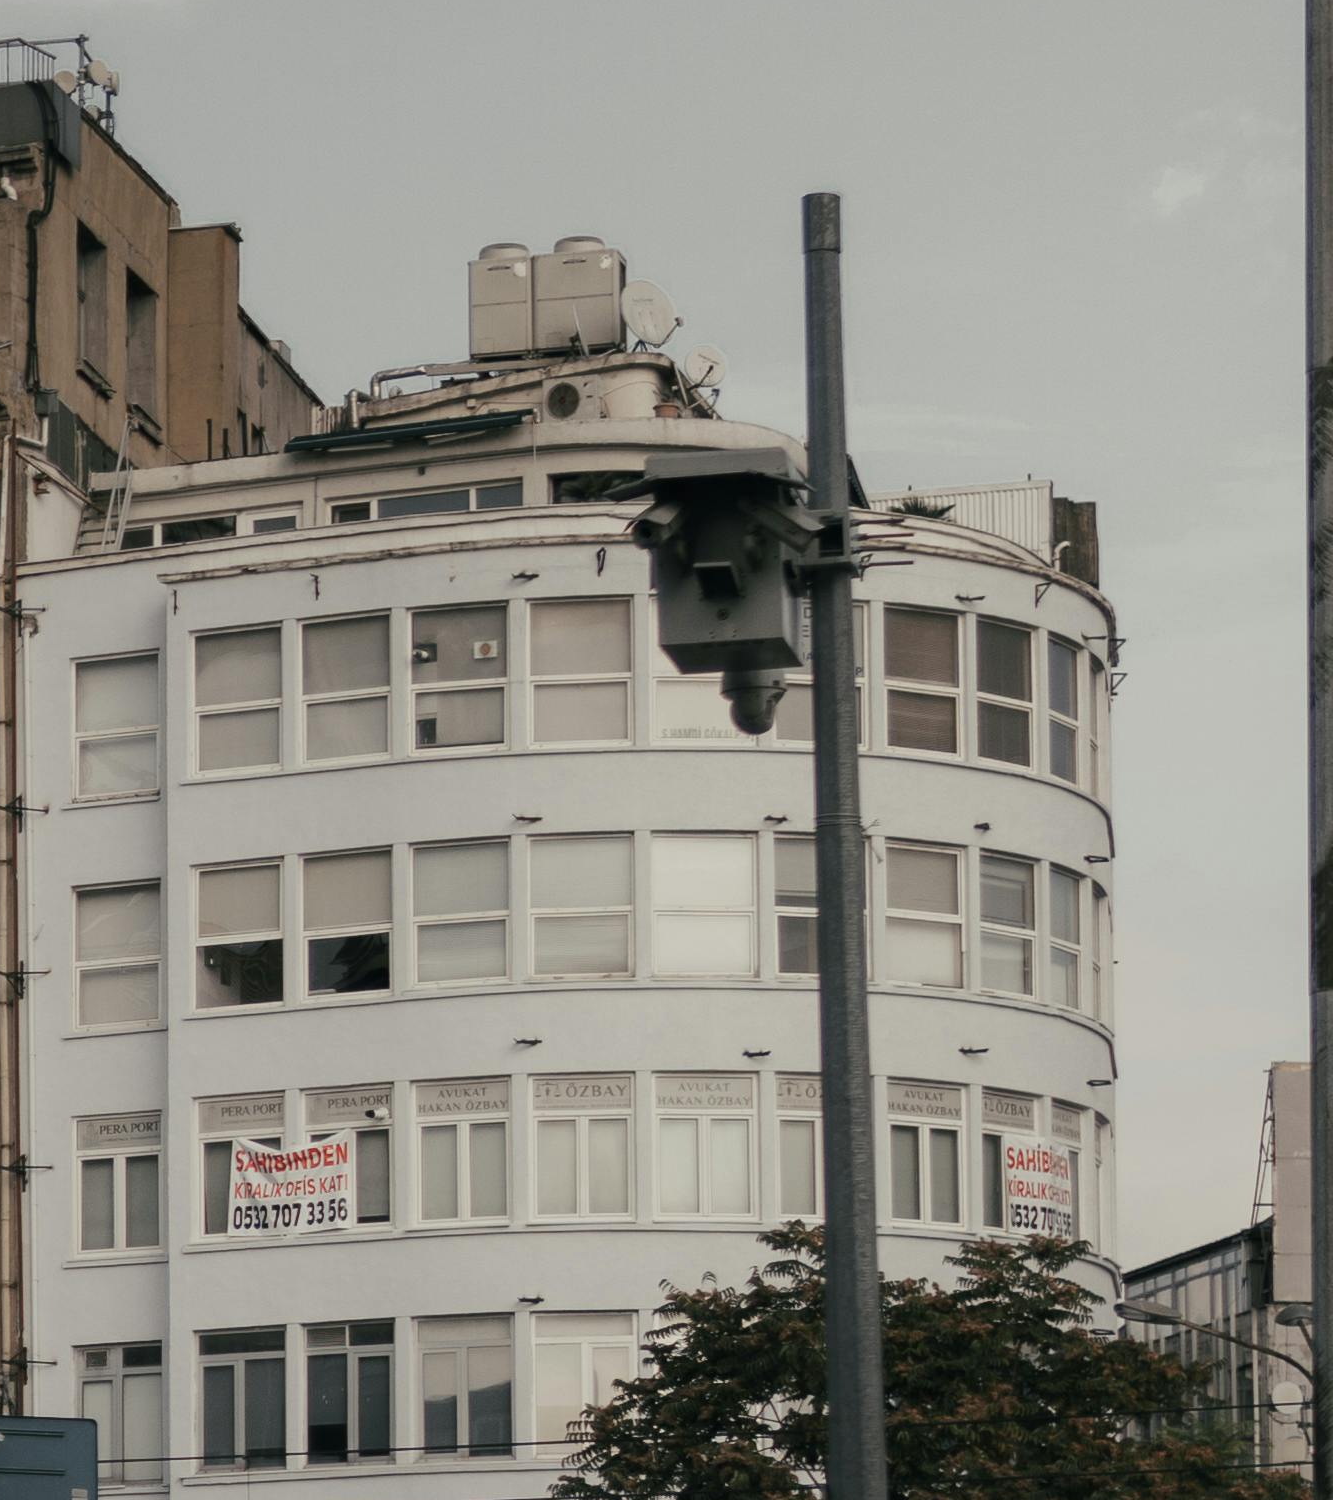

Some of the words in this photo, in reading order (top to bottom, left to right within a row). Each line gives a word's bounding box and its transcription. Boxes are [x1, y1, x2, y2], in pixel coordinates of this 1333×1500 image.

[437, 1087, 487, 1099] AVUKAT
[565, 1082, 627, 1098] ÖZBAY
[678, 1082, 732, 1092] AVUKAT
[327, 1097, 357, 1109] PERA
[360, 1094, 390, 1107] PORT
[657, 1096, 702, 1106] HAKAN
[708, 1094, 751, 1106] ÖZBAY
[904, 1090, 944, 1101] AVUKAT
[221, 1105, 250, 1117] PERA
[253, 1102, 283, 1115] PORT
[418, 1102, 461, 1113] HAKAN
[465, 1100, 506, 1111] ÖZBAY
[888, 1101, 923, 1113] HAKAN
[926, 1104, 961, 1116] ÖZBAY
[996, 1100, 1030, 1118] ÖZBAY
[99, 1123, 128, 1135] PERA
[131, 1121, 159, 1133] PORT
[286, 1175, 316, 1197] OFİS
[319, 1174, 348, 1194] KATI
[1008, 1174, 1047, 1200] KİRALIK
[233, 1205, 269, 1230] 0532
[271, 1203, 301, 1228] 707
[307, 1201, 324, 1225] 33
[328, 1198, 348, 1222] 56
